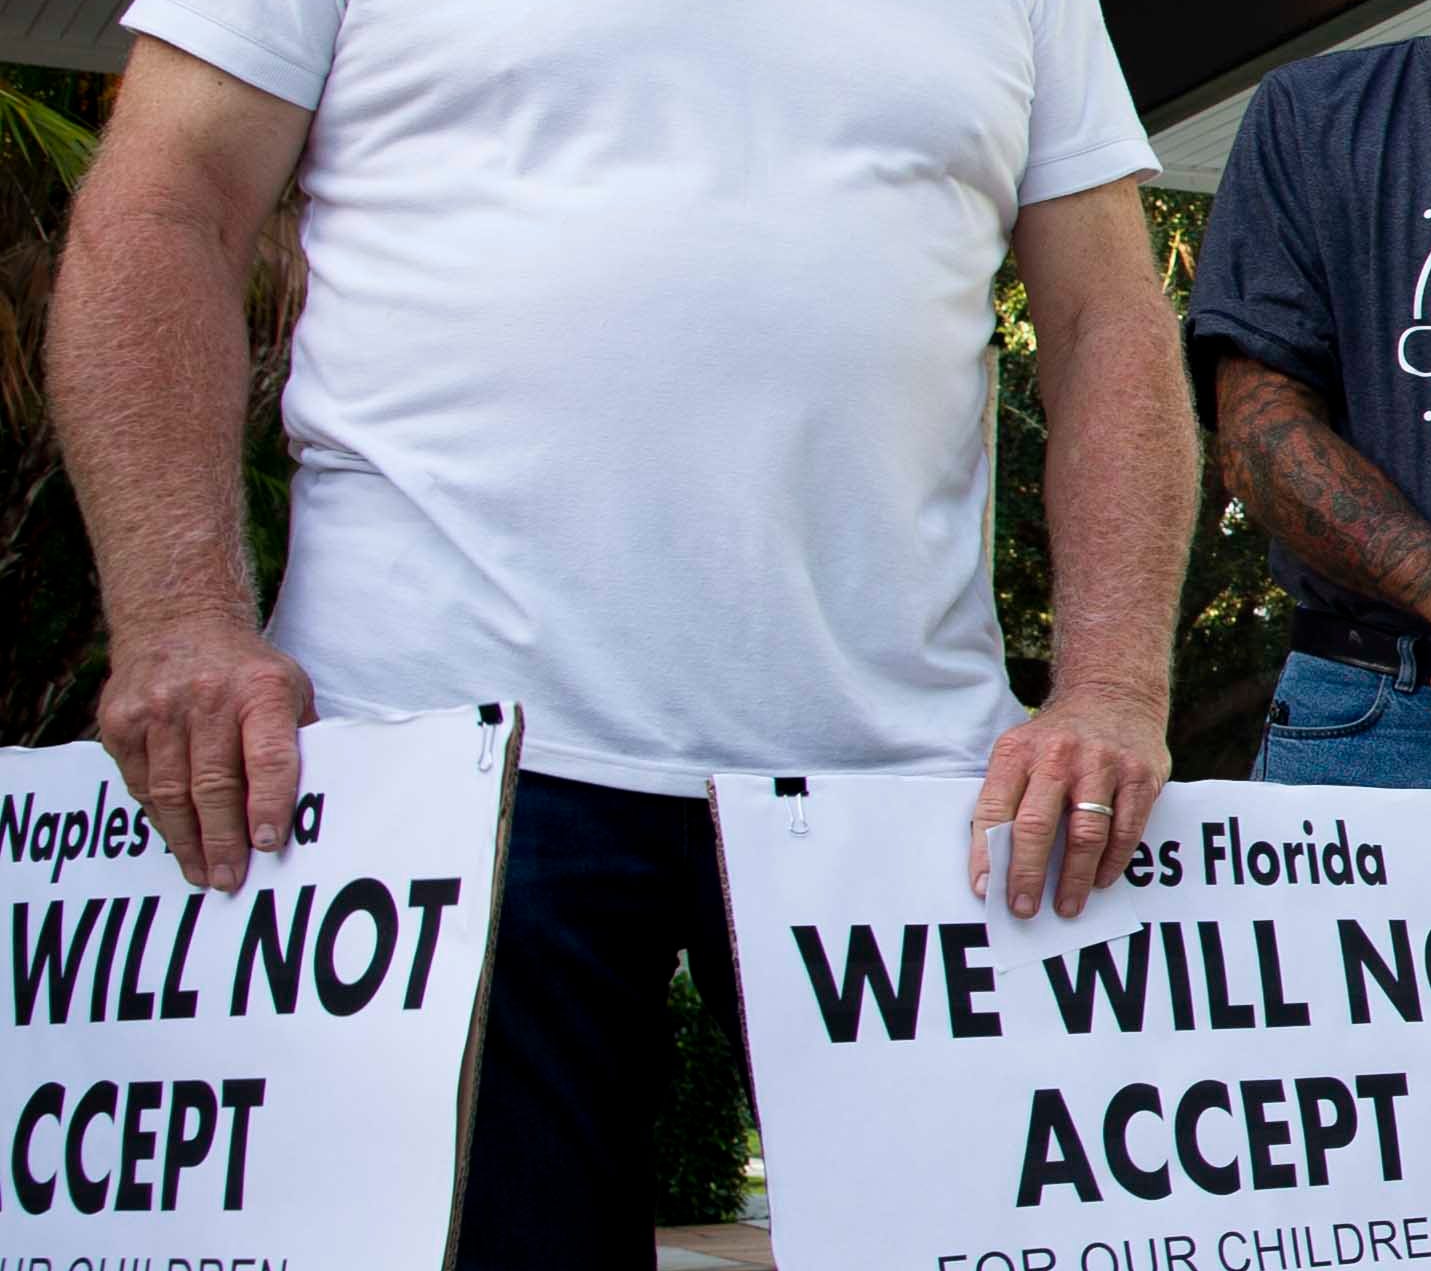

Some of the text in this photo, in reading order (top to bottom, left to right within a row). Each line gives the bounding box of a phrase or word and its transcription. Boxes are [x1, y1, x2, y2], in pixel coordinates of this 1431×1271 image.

[0, 781, 150, 883] Naples
[1202, 817, 1387, 885] Florida
[13, 878, 461, 1026] WILL NOT
[791, 923, 1002, 1043] WE
[1043, 920, 1310, 1034] WILL
[0, 1079, 265, 1215] CCEPT
[1016, 1073, 1408, 1207] ACCEPT
